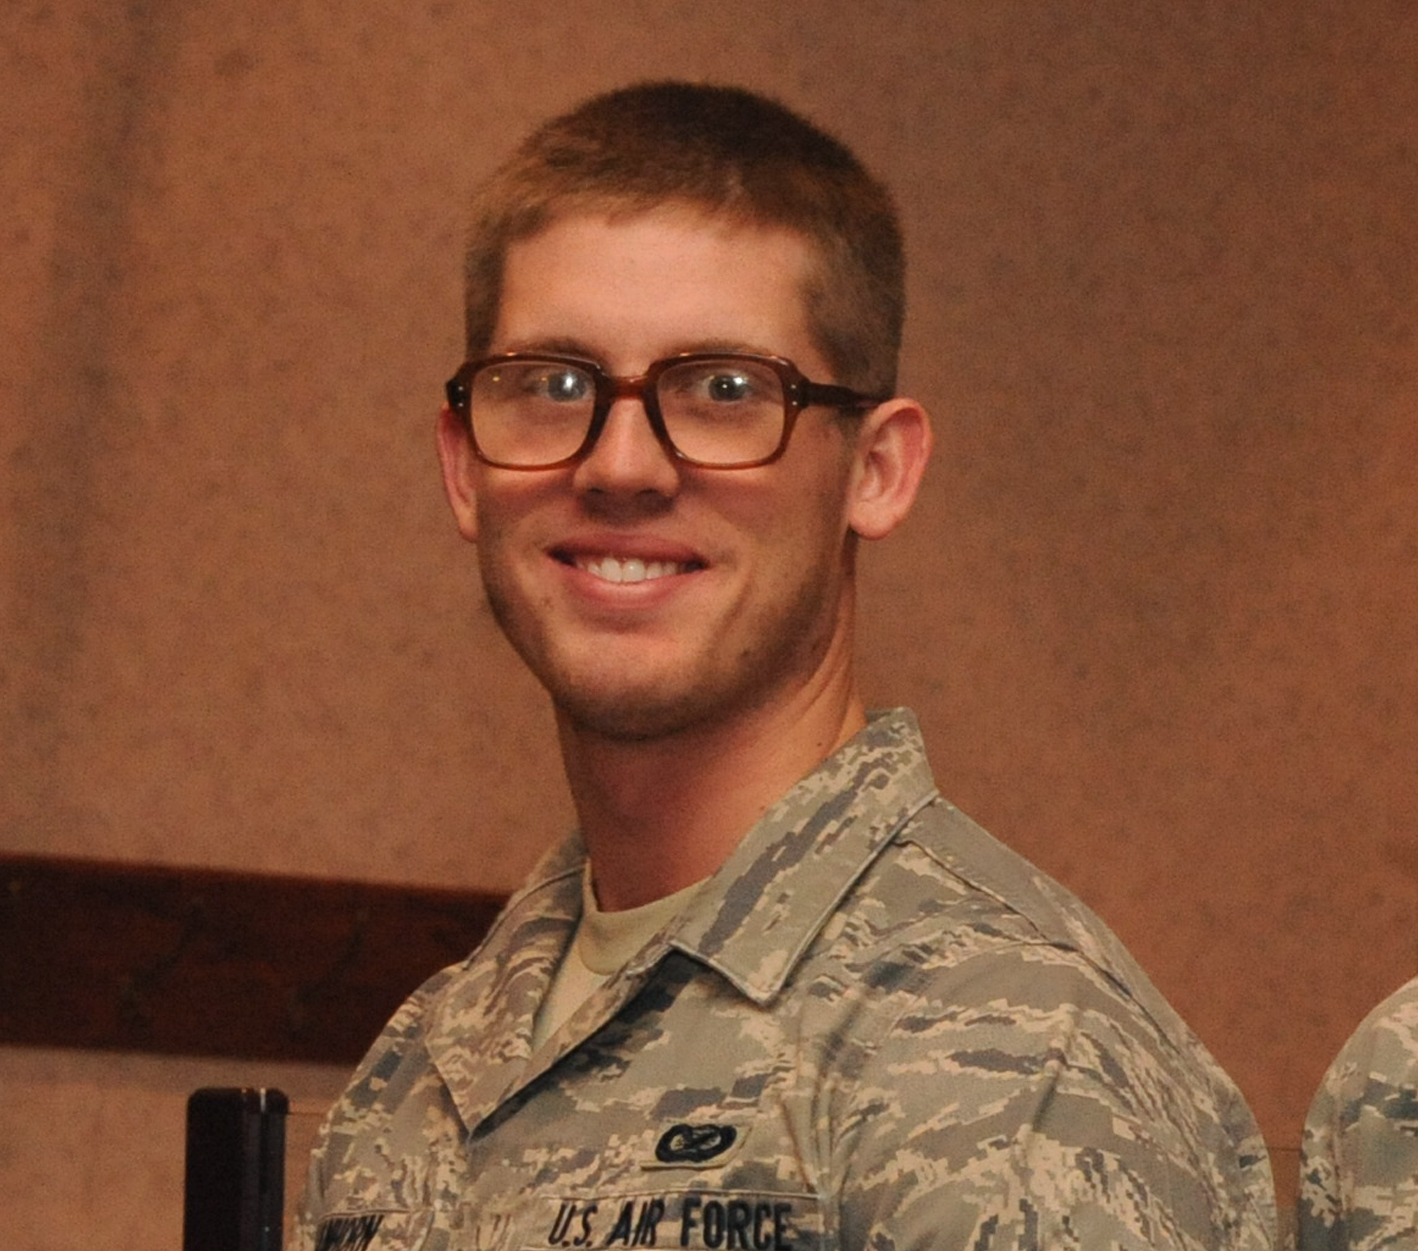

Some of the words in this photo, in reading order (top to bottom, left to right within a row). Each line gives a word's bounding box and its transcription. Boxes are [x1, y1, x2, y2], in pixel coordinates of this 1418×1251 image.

[548, 1202, 598, 1247] U.S.
[605, 1198, 665, 1247] AIR
[681, 1195, 793, 1251] FORCE
